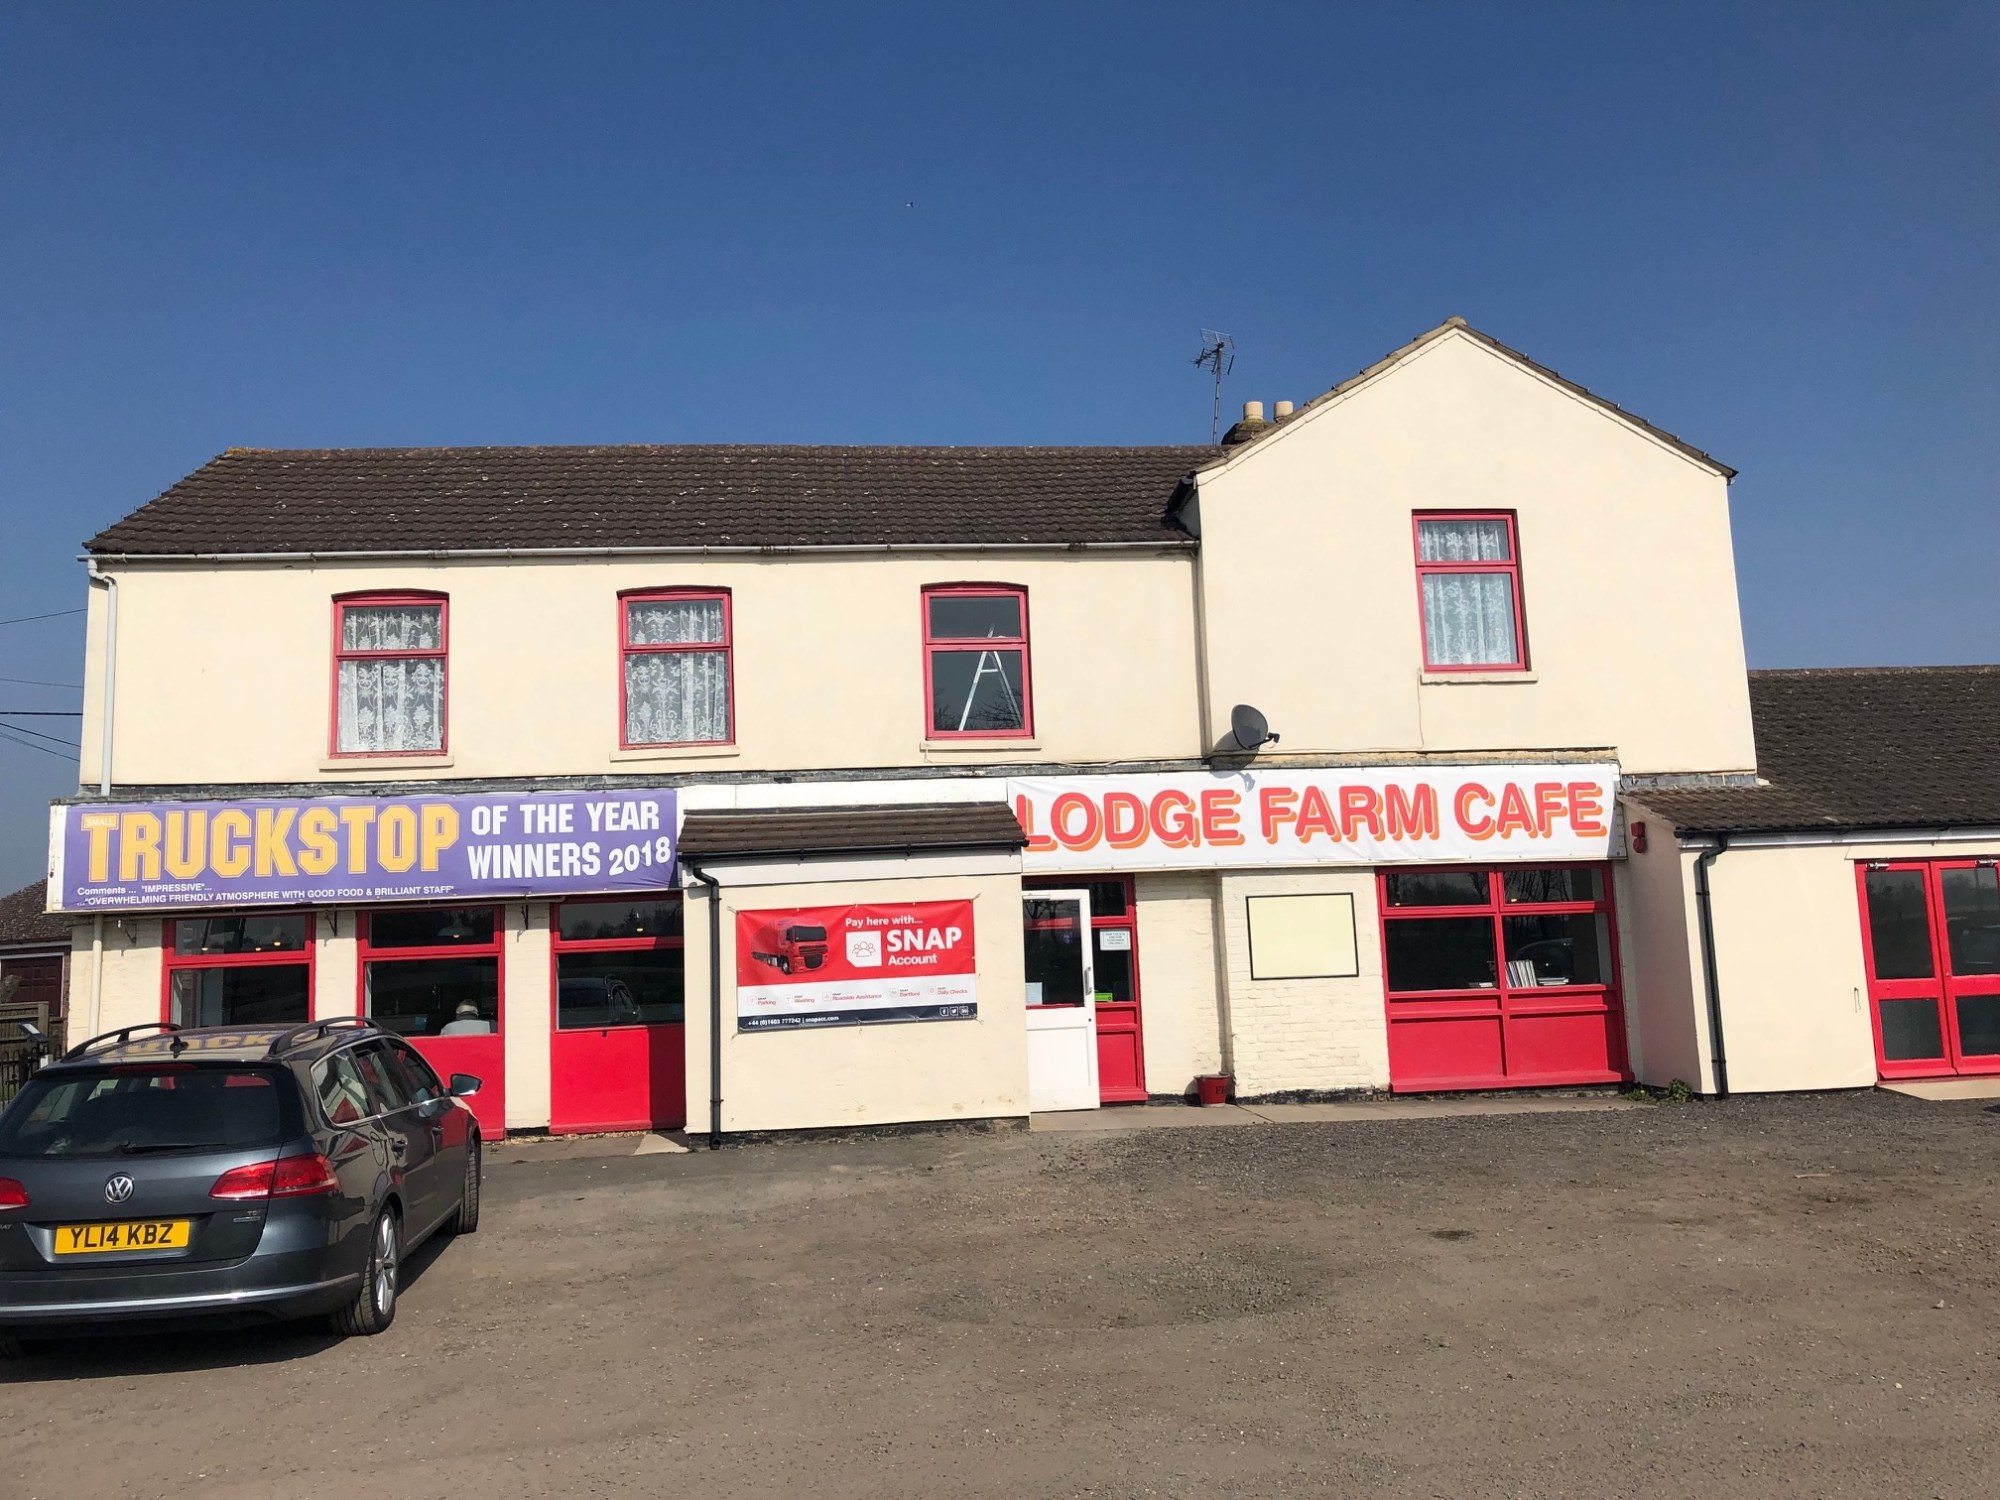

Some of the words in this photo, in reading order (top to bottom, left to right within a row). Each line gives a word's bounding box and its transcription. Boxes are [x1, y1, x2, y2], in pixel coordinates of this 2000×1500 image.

[471, 805, 508, 835] OF
[520, 803, 574, 835] THE
[585, 801, 659, 832] YEAR
[1016, 789, 1245, 851] LODGE
[1259, 784, 1440, 844] FARM
[1454, 782, 1607, 841] CAFE
[81, 805, 460, 882] TRUCKSTOP
[467, 842, 601, 880] WINNERS
[609, 837, 671, 876] 2018
[77, 886, 126, 896] Comments
[169, 893, 214, 903] FRIENDLY
[215, 890, 279, 901] ATMOSPHERE
[282, 890, 305, 899] WITH
[307, 889, 336, 898] GOOD
[337, 888, 364, 897] FOOD
[366, 888, 372, 896] &
[375, 887, 421, 896] BRILLIANT
[845, 917, 863, 929] Pay
[866, 916, 889, 926] here
[886, 926, 962, 952] SNAP
[888, 953, 938, 966] Account
[71, 1227, 119, 1248] YL14
[127, 1223, 173, 1245] KBZ
